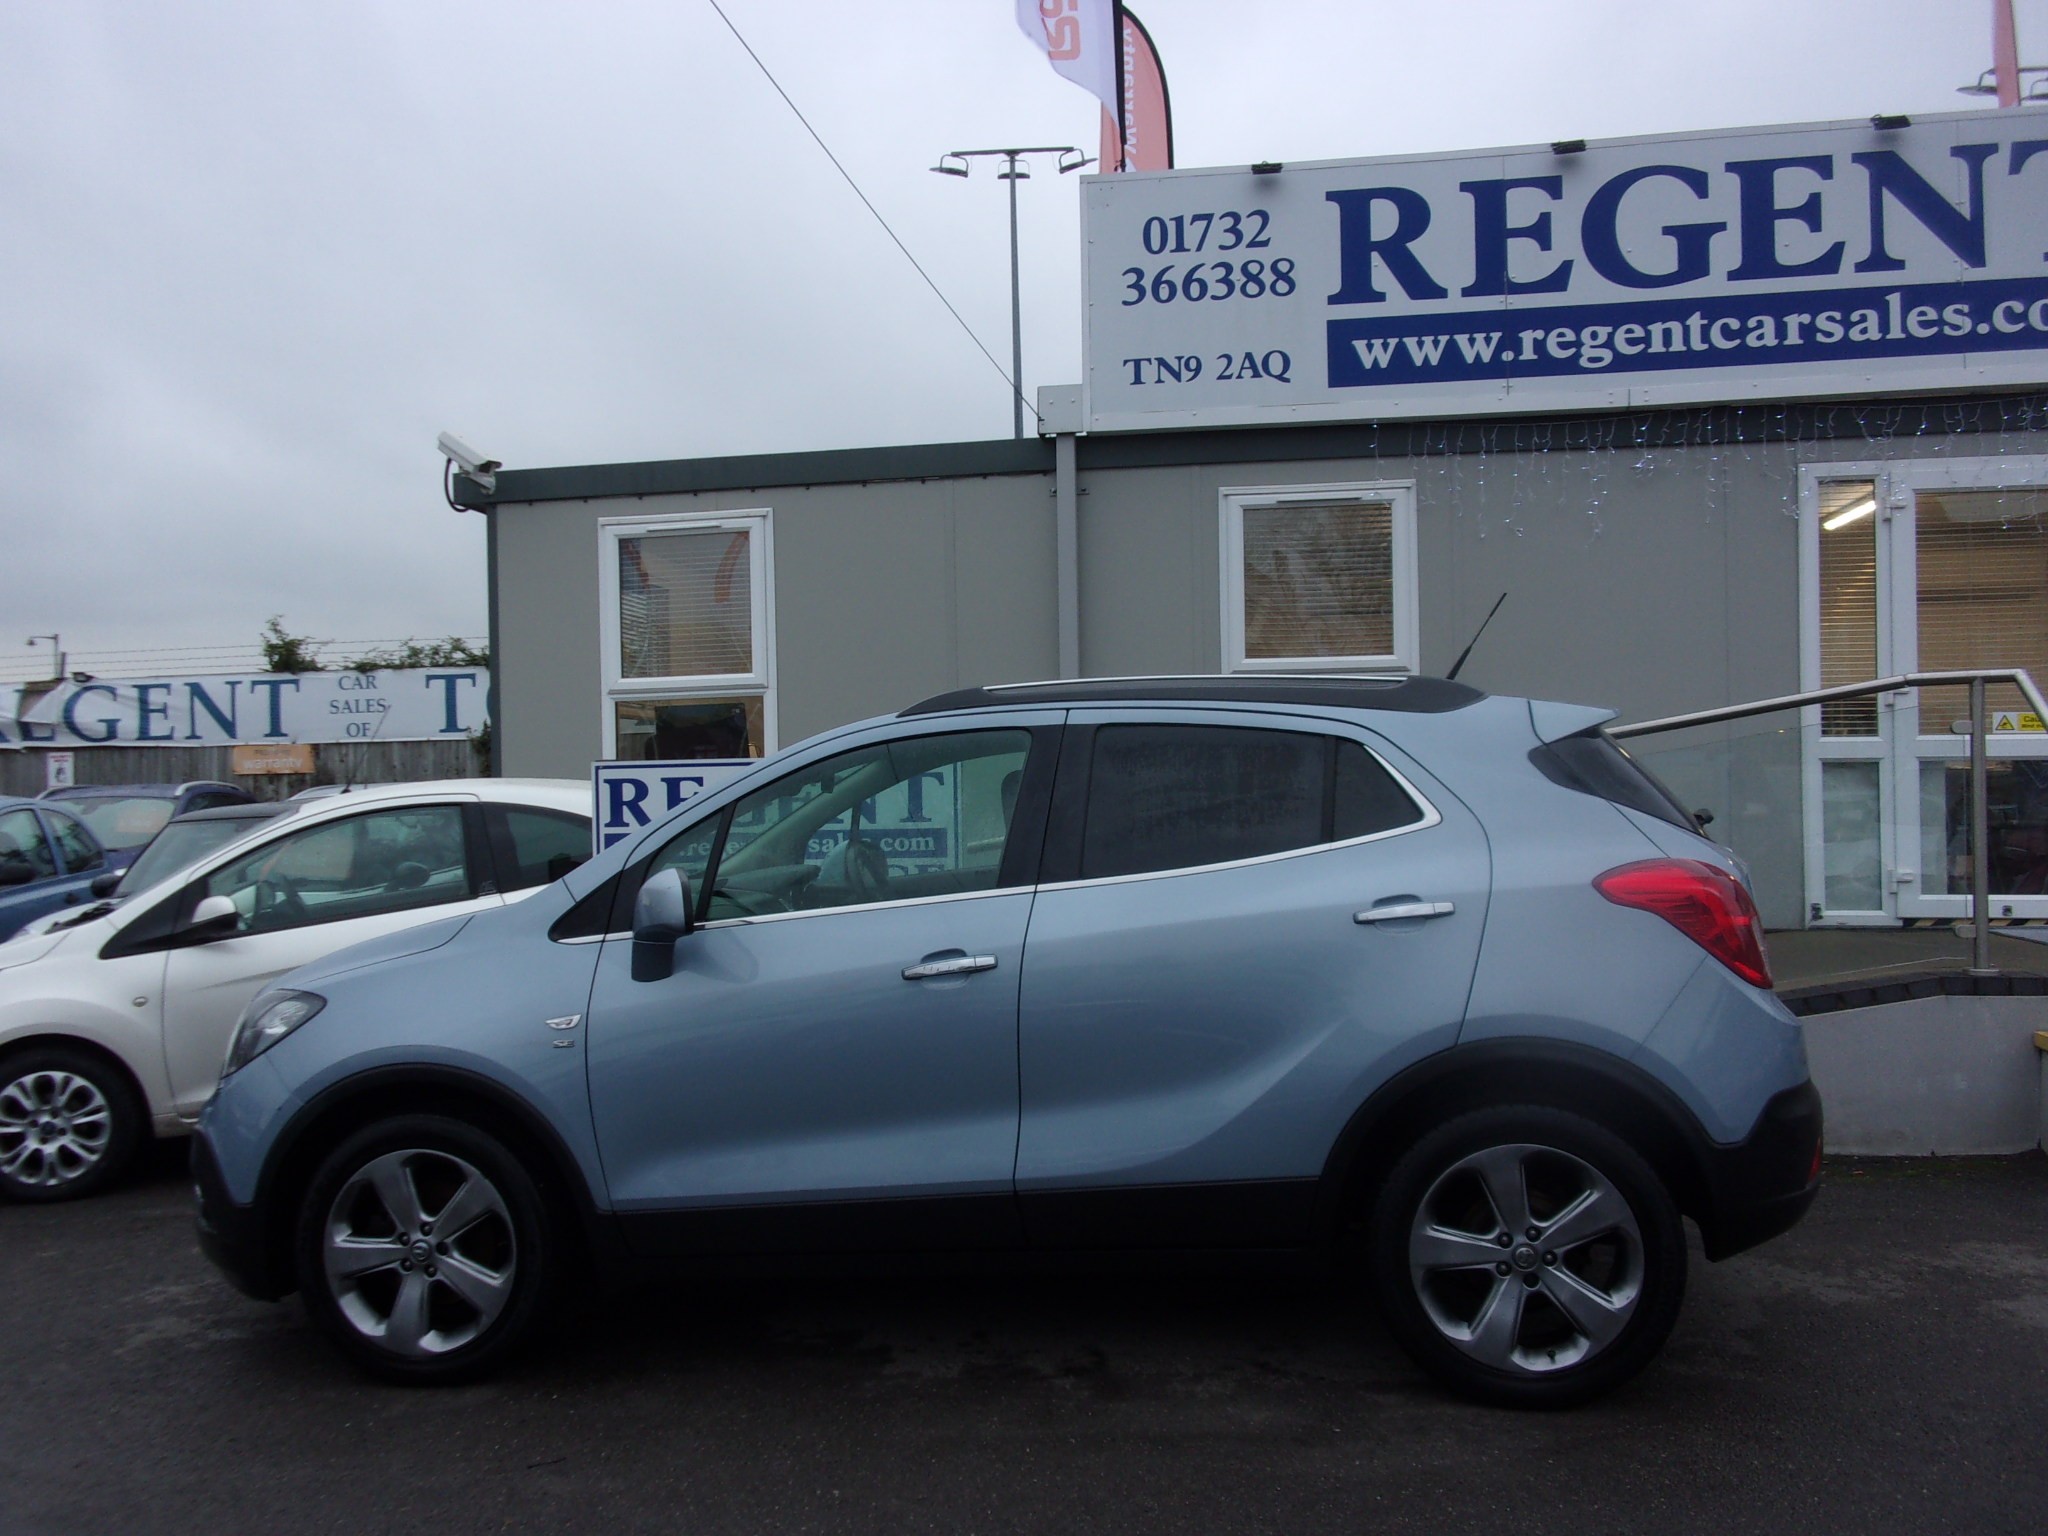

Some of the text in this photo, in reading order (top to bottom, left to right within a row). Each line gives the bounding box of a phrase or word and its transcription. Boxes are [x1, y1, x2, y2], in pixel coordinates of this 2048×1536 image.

[1142, 209, 1272, 255] 01732
[1121, 257, 1296, 307] 366388
[1122, 350, 1291, 386] TN9 2AQ
[338, 675, 378, 690] CAR
[329, 698, 387, 715] SALES
[425, 673, 489, 733] T
[346, 722, 372, 738] OF
